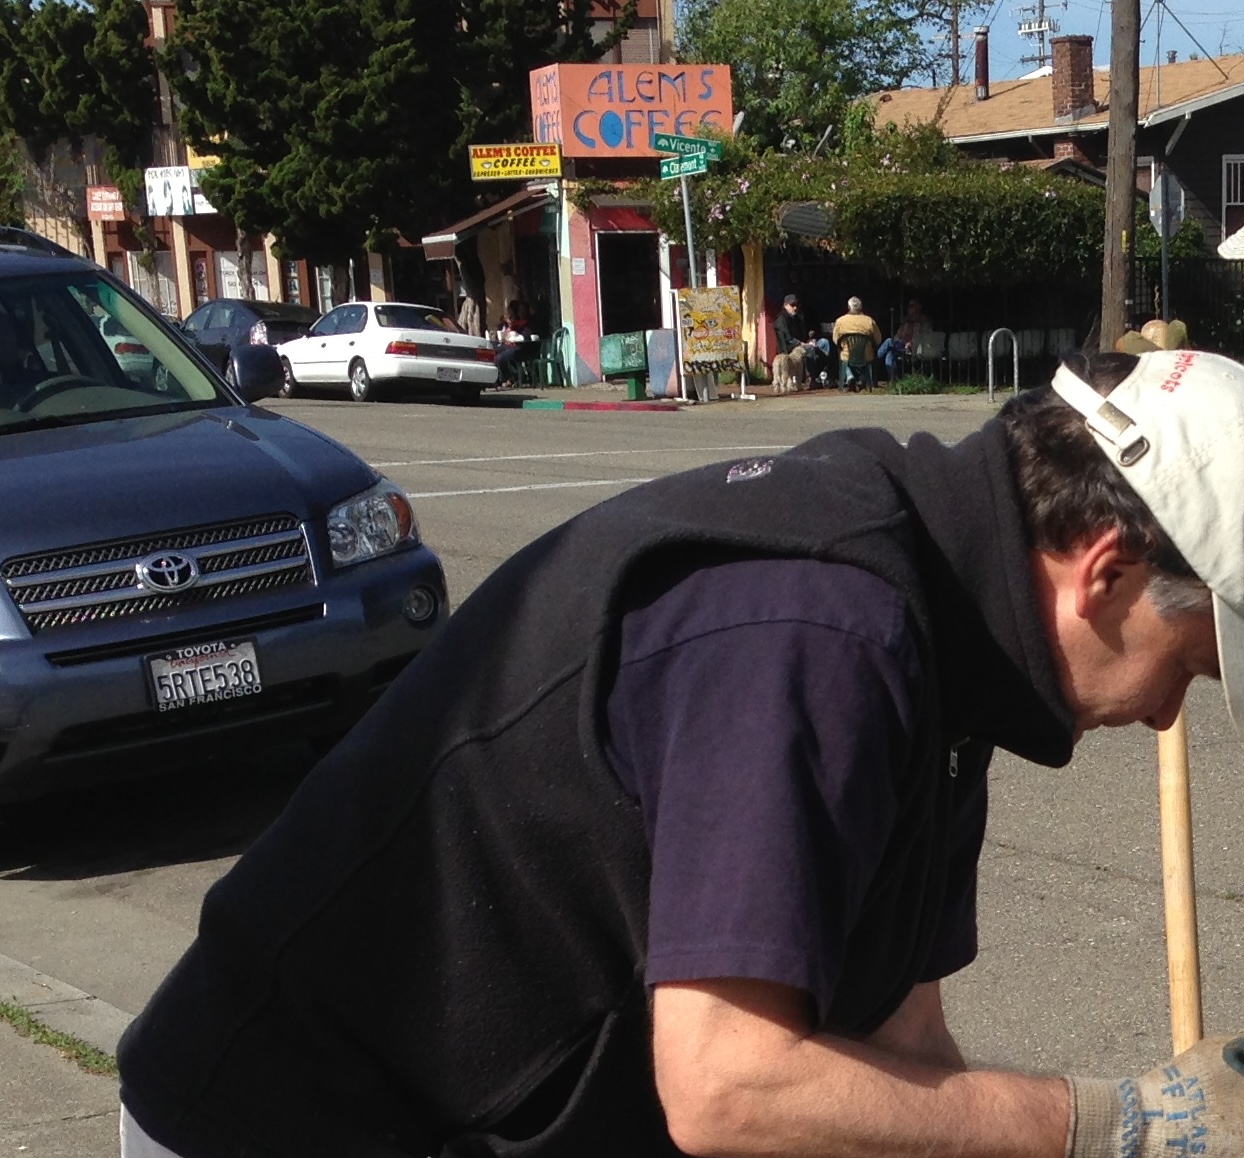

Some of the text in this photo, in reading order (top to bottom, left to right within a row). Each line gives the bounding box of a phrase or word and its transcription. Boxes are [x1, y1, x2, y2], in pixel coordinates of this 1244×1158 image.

[513, 145, 557, 157] COFFEE
[669, 138, 707, 154] Vicente
[493, 157, 536, 169] COFFEE
[669, 158, 698, 174] Claemont
[176, 642, 227, 659] TOYOTA
[157, 659, 256, 701] 5RTE538
[158, 683, 262, 713] SAN FRANCISCO
[1186, 1076, 1208, 1155] ATLAS
